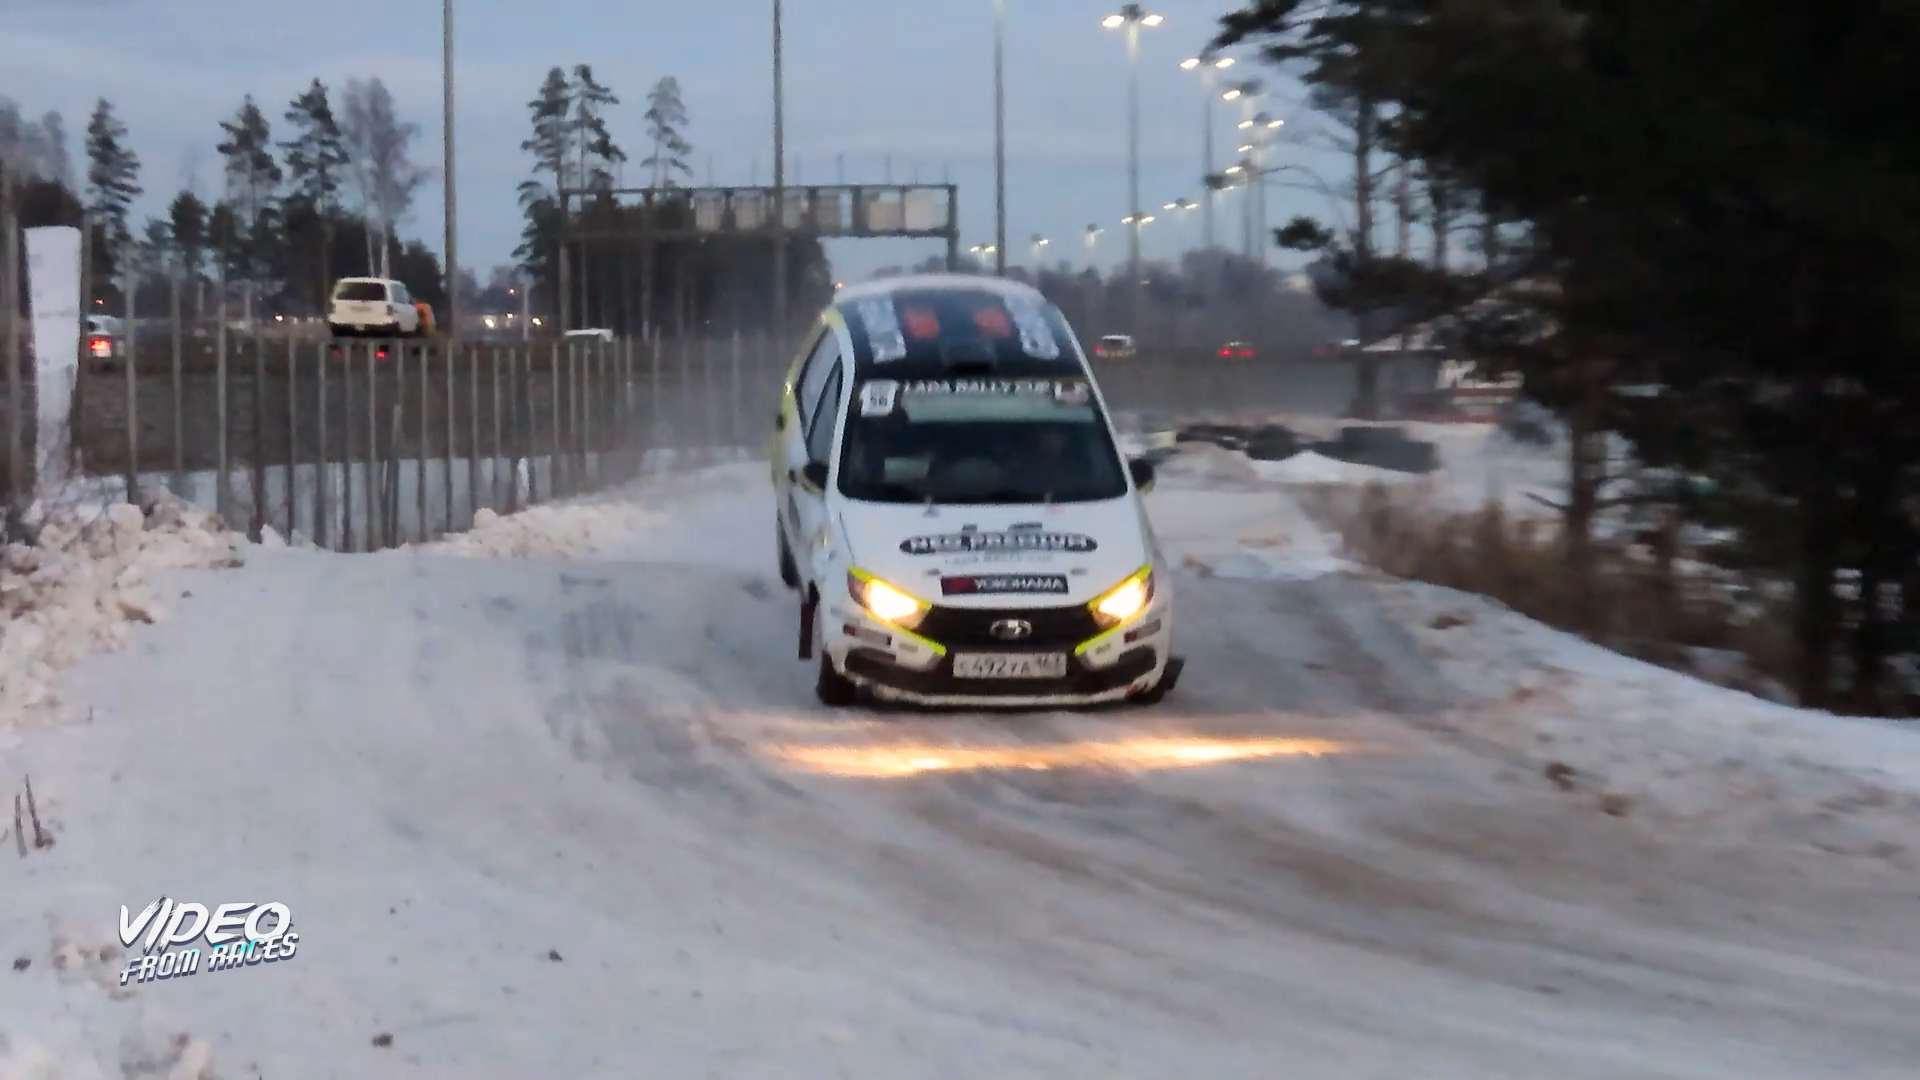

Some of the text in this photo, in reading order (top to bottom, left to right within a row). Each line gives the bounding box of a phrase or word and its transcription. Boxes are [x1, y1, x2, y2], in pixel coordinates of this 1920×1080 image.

[903, 379, 950, 393] LADA
[955, 379, 1011, 393] RALLY
[975, 577, 1064, 590] YOKOHAMA
